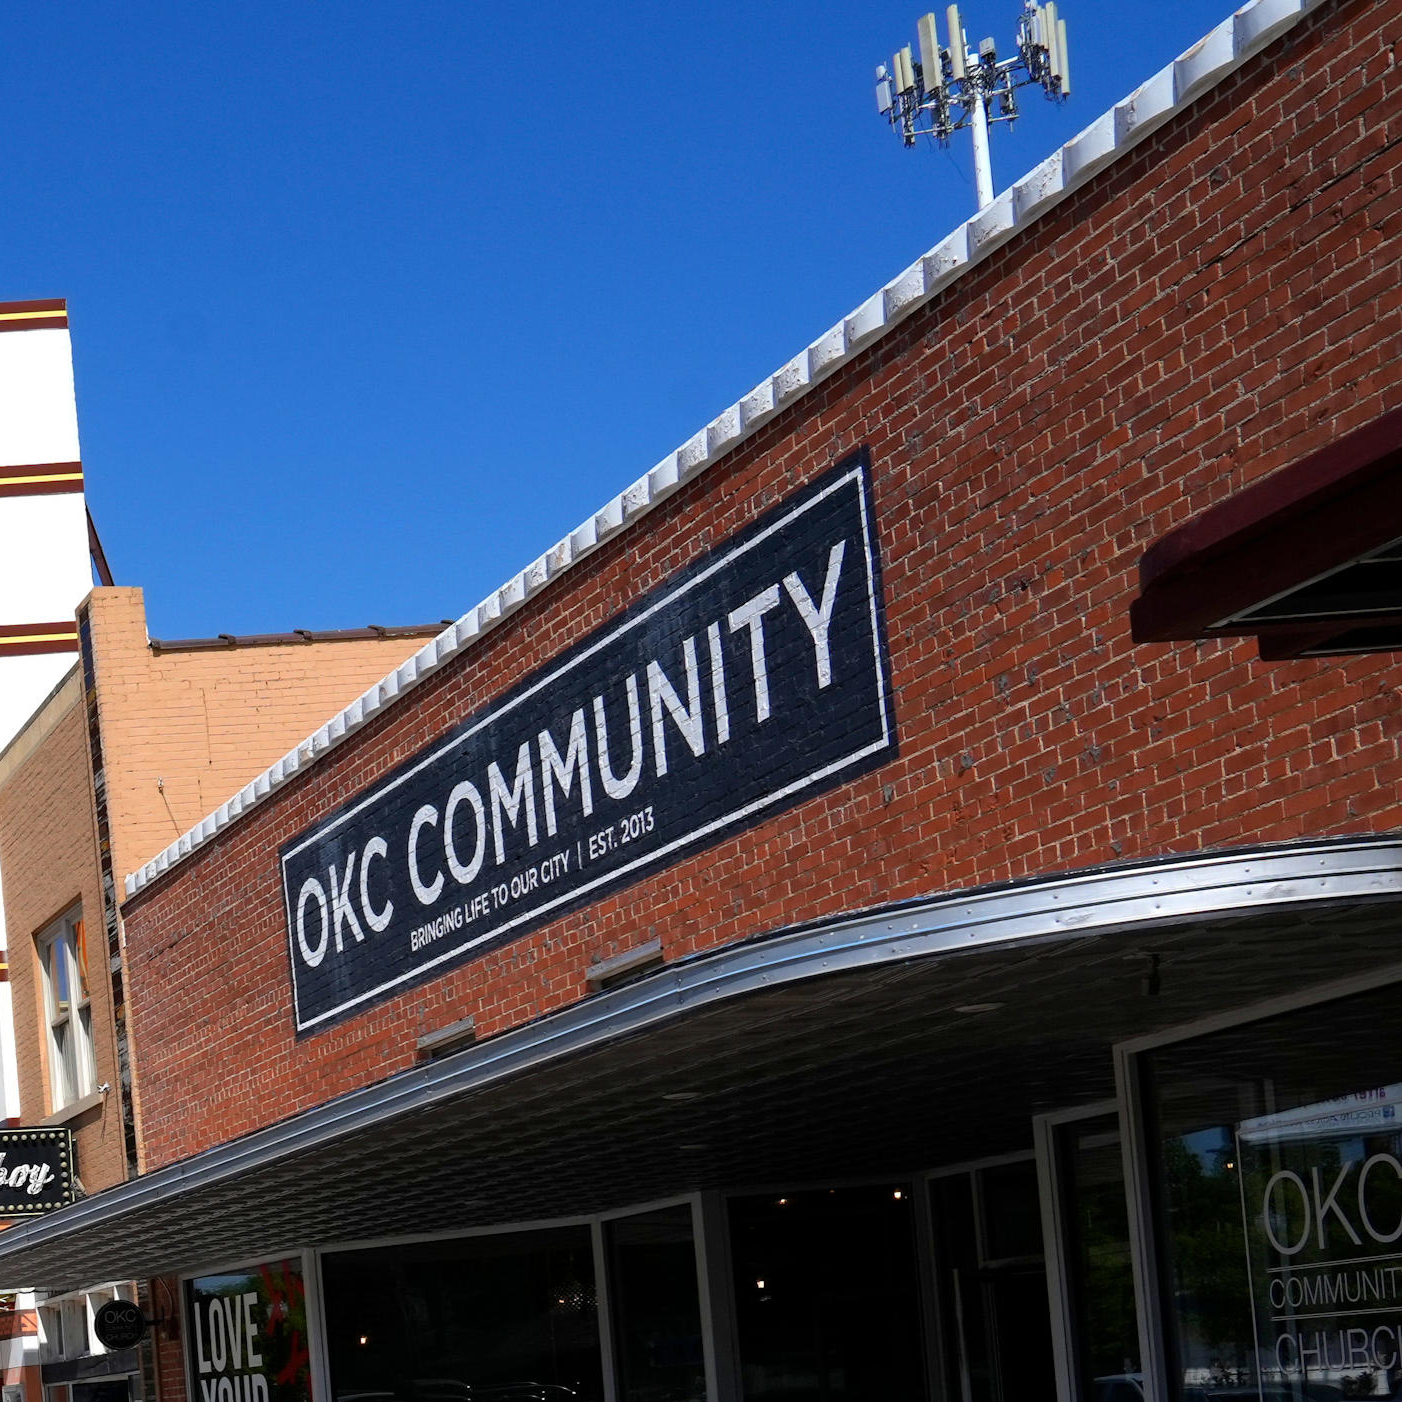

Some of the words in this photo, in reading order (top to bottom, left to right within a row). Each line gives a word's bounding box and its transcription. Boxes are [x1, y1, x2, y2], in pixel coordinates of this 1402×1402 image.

[296, 836, 394, 967] OKC
[407, 540, 846, 905] COMMUNITY
[410, 906, 464, 951] BRINGING
[464, 899, 490, 930] LIFE
[491, 886, 508, 909] TO
[510, 868, 538, 899] OUR
[540, 850, 570, 884] CITY
[589, 828, 617, 860] EST.
[620, 806, 655, 844] 2013
[1263, 1152, 1402, 1256] OKC
[105, 1309, 136, 1323] OKC
[194, 1291, 262, 1374] LOVE
[1276, 1325, 1402, 1374] CHURC
